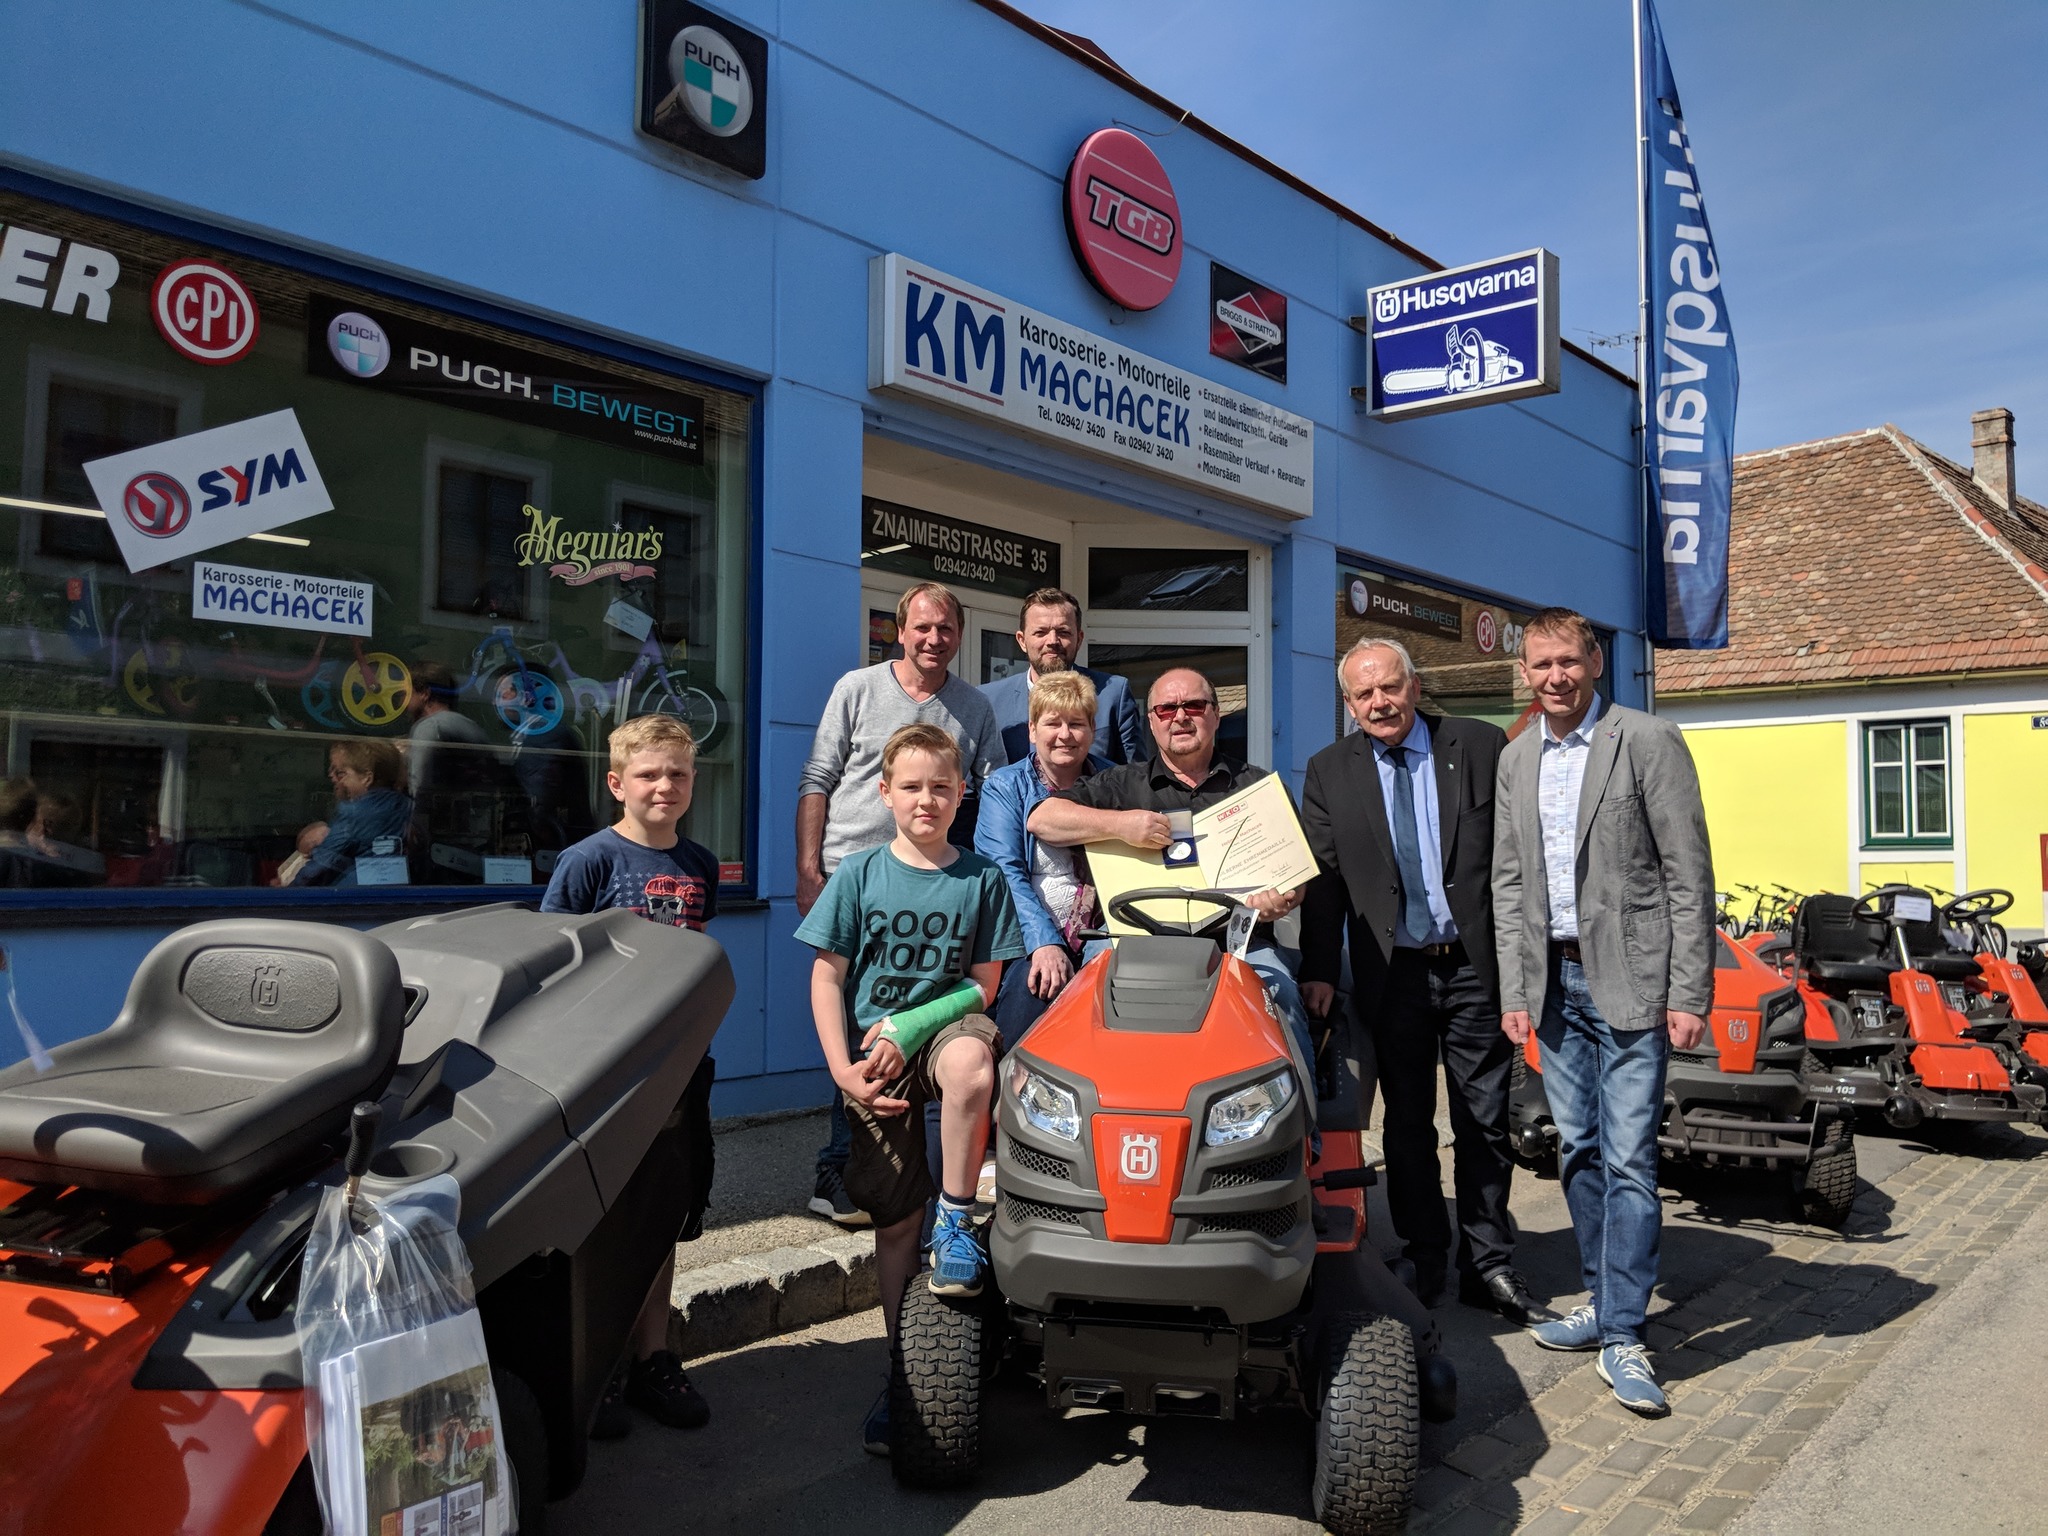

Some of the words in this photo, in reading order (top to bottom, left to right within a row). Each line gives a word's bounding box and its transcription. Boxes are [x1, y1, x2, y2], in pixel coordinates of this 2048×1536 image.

[684, 40, 740, 81] PUCH
[1086, 174, 1175, 256] TGB
[1402, 265, 1536, 314] Husqvarna
[175, 282, 238, 342] CPI
[1220, 306, 1242, 324] BRIGGS
[1243, 317, 1248, 326] &
[1248, 319, 1278, 340] STRATTON
[338, 322, 380, 343] PUCH
[905, 282, 1006, 396] KM
[1020, 315, 1106, 369] Karosserie
[1118, 354, 1191, 401] Motorteile
[410, 346, 540, 400] PUCH.
[553, 384, 697, 439] BEWEGT.
[1020, 347, 1191, 447] MACHACEK
[1203, 388, 1237, 411] Ersatzteile
[1239, 403, 1272, 424] sämtlicher
[1272, 416, 1308, 438] Automarken
[1203, 408, 1216, 421] und
[1268, 431, 1288, 447] Geräte
[634, 429, 697, 450] www.puch-bike.at
[1037, 405, 1053, 422] Tel.
[1055, 411, 1084, 431] 02942/
[1087, 421, 1106, 438] 3420
[1113, 431, 1127, 446] Fax
[1128, 435, 1153, 453] 02942/
[1156, 445, 1174, 461] 3420
[1203, 425, 1244, 448] Reifendienst
[198, 448, 307, 513] SYM
[1202, 461, 1241, 483] Motorsägen
[1203, 442, 1243, 466] Rasenmäher
[1244, 456, 1270, 475] Verkauf
[1277, 468, 1306, 487] Reparatur
[514, 504, 663, 579] Meguiar's
[872, 509, 1023, 568] ZNAIMERSTRASSE
[1031, 548, 1047, 573] 35
[203, 567, 283, 589] Karosserie
[293, 579, 365, 600] Motorteile
[594, 566, 613, 577] since
[615, 563, 631, 573] 1901
[934, 554, 996, 582] 02942/3420
[203, 584, 364, 625] MACHACEK
[1373, 595, 1411, 616] PUCH.
[1414, 605, 1460, 628] BEWEGT.
[1479, 618, 1493, 645] CPI
[1502, 622, 1523, 655] CP
[1217, 805, 1240, 821] WKO
[865, 909, 968, 941] COOL
[862, 941, 963, 974] MODE
[876, 984, 906, 1001] ON
[1809, 1084, 1834, 1093] Combi
[1835, 1086, 1857, 1095] 103
